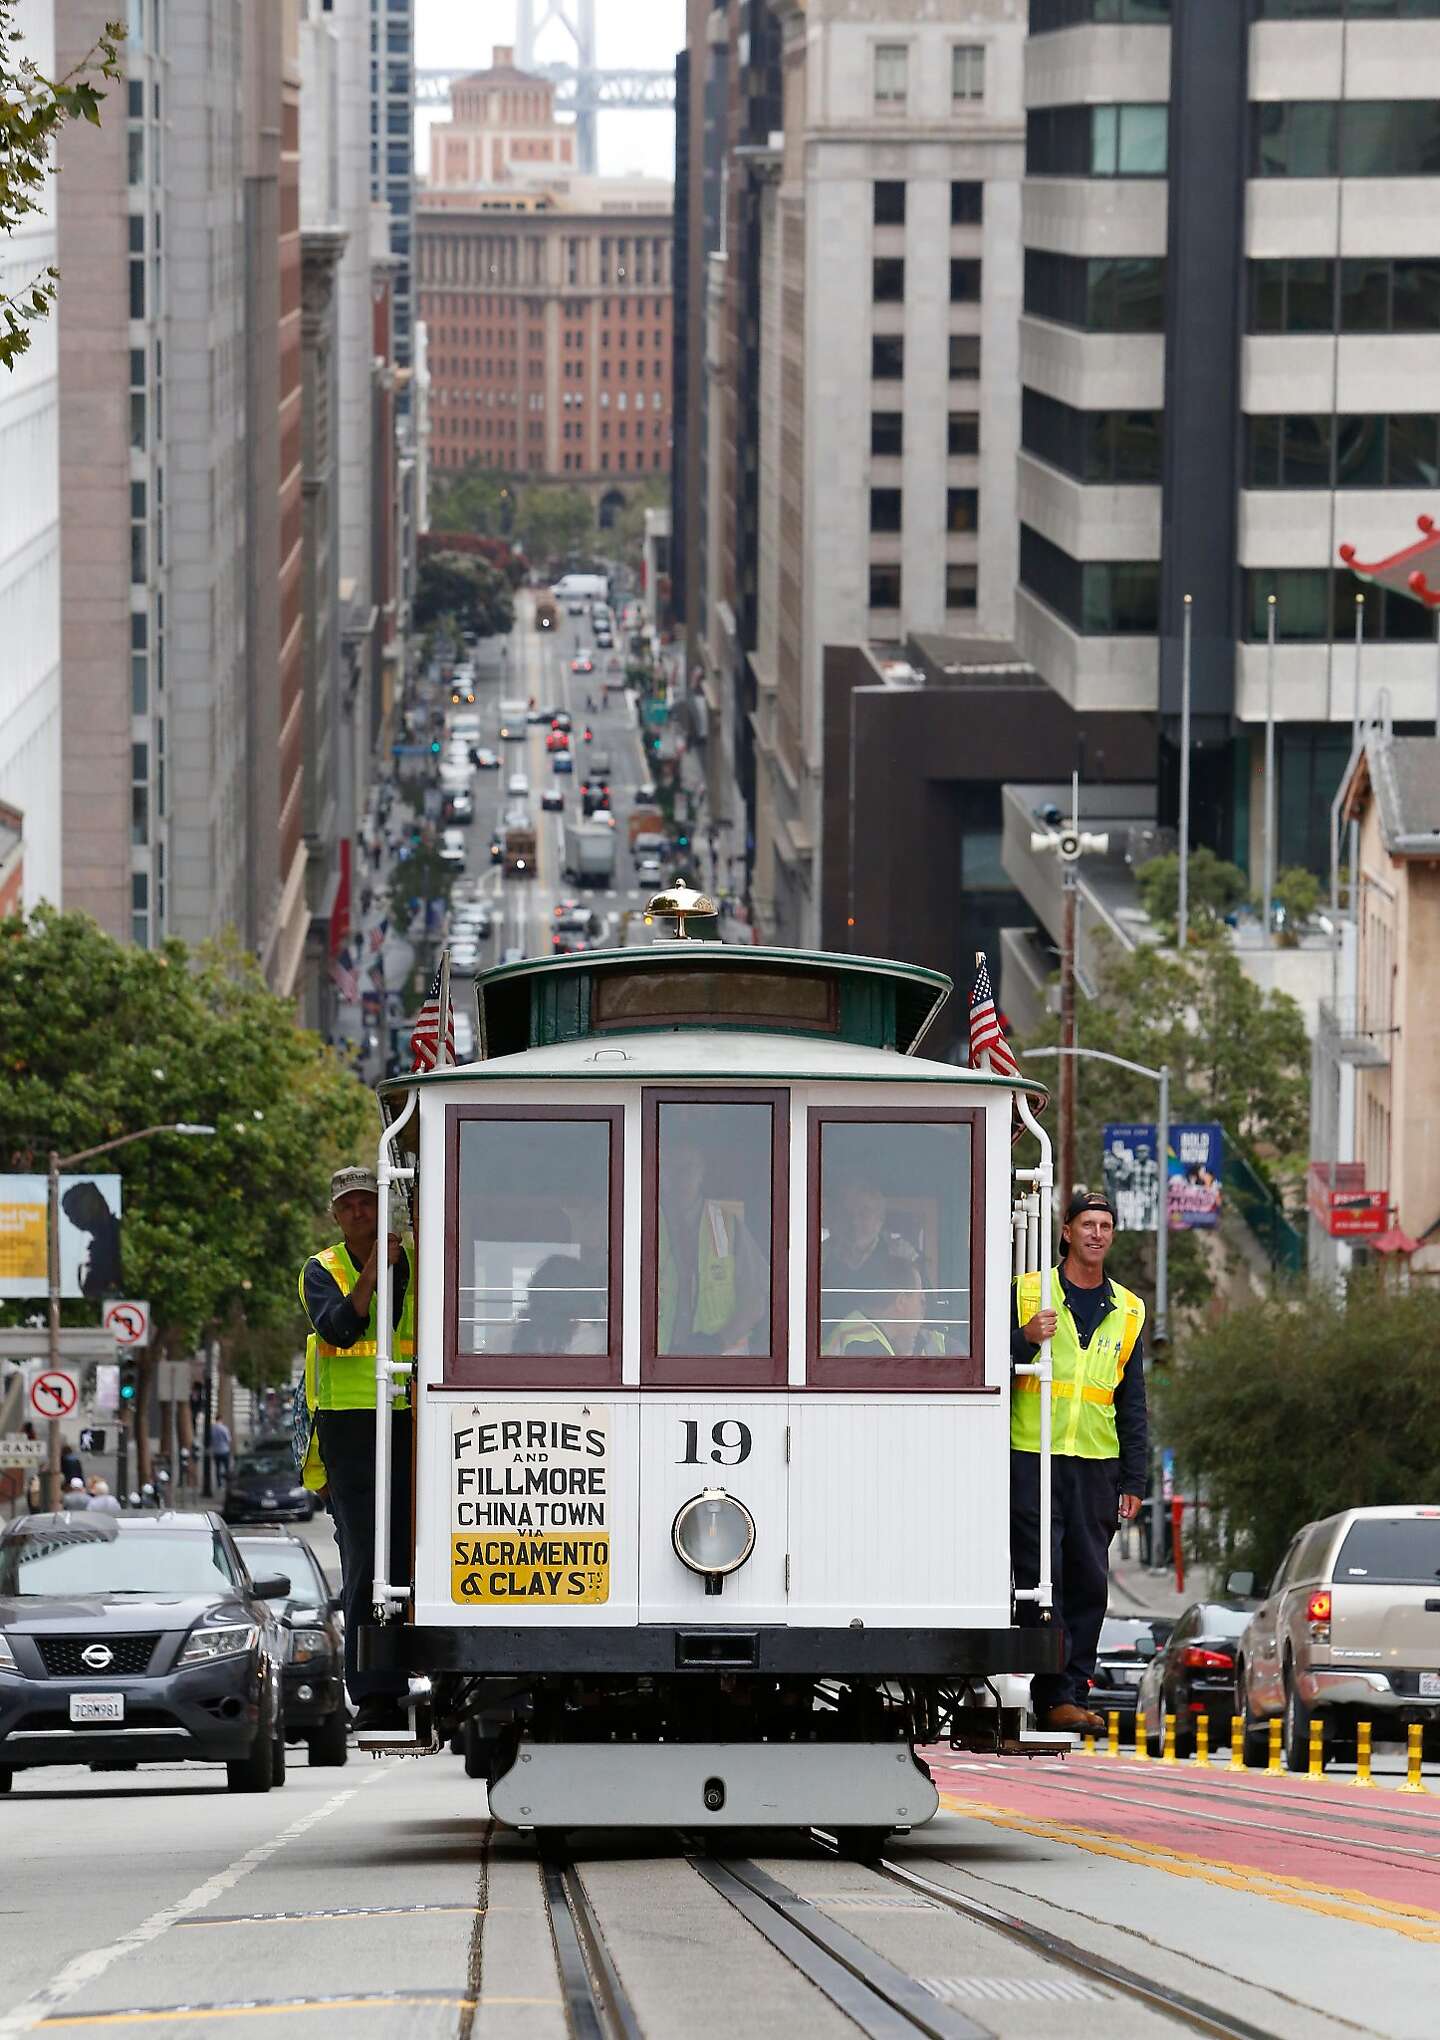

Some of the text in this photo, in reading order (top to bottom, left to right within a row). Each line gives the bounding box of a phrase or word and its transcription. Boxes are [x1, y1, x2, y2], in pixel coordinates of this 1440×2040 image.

[453, 1420, 606, 1460] FERRIES
[675, 1419, 752, 1466] 19
[512, 1452, 549, 1463] AND
[457, 1467, 606, 1496] FILLMORE
[457, 1502, 605, 1526] CHINATOWN
[516, 1528, 544, 1538] VIA
[454, 1541, 608, 1566] SACRAMENTO
[460, 1572, 483, 1596] &
